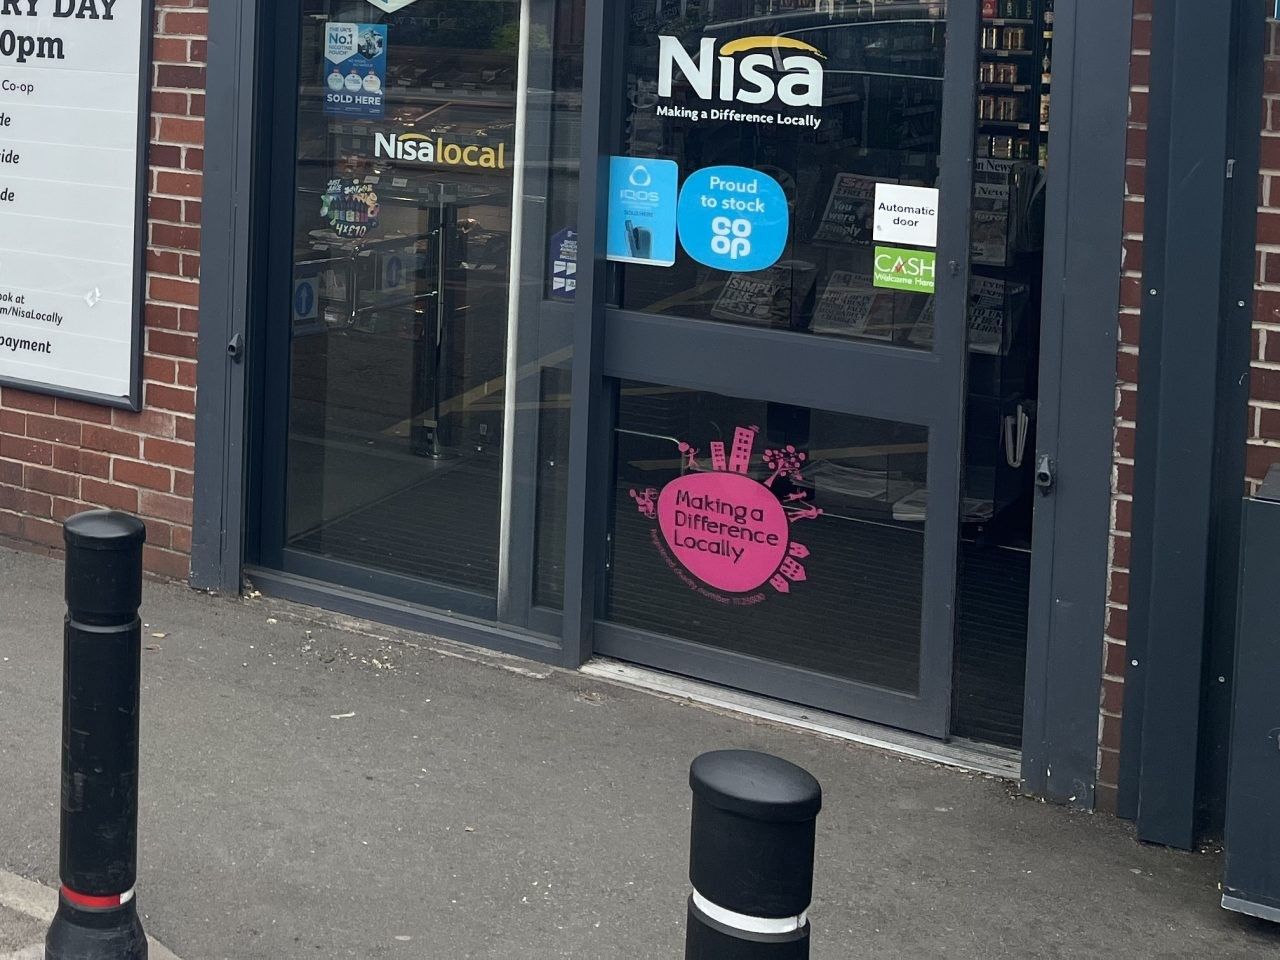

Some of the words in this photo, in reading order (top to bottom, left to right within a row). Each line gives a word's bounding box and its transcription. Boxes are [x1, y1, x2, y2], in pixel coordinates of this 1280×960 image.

[328, 33, 353, 45] No.1
[657, 34, 824, 107] Nisa
[2, 80, 34, 95] Co-op
[327, 94, 353, 103] SOLD
[355, 96, 381, 106] HERE
[656, 105, 699, 122] Making
[700, 110, 708, 119] a
[710, 108, 774, 124] Difference
[777, 112, 822, 130] Locally
[709, 176, 758, 194] Proud
[700, 194, 717, 208] to
[722, 196, 765, 213] stock
[878, 202, 935, 216] Automatic
[892, 217, 920, 227] door
[875, 254, 936, 278] CASH
[730, 278, 780, 296] SIMPLY
[874, 271, 913, 285] Welcome
[15, 295, 25, 305] at
[675, 490, 748, 524] Making
[750, 508, 764, 522] a
[674, 510, 780, 547] Difference
[674, 529, 745, 565] Locally
